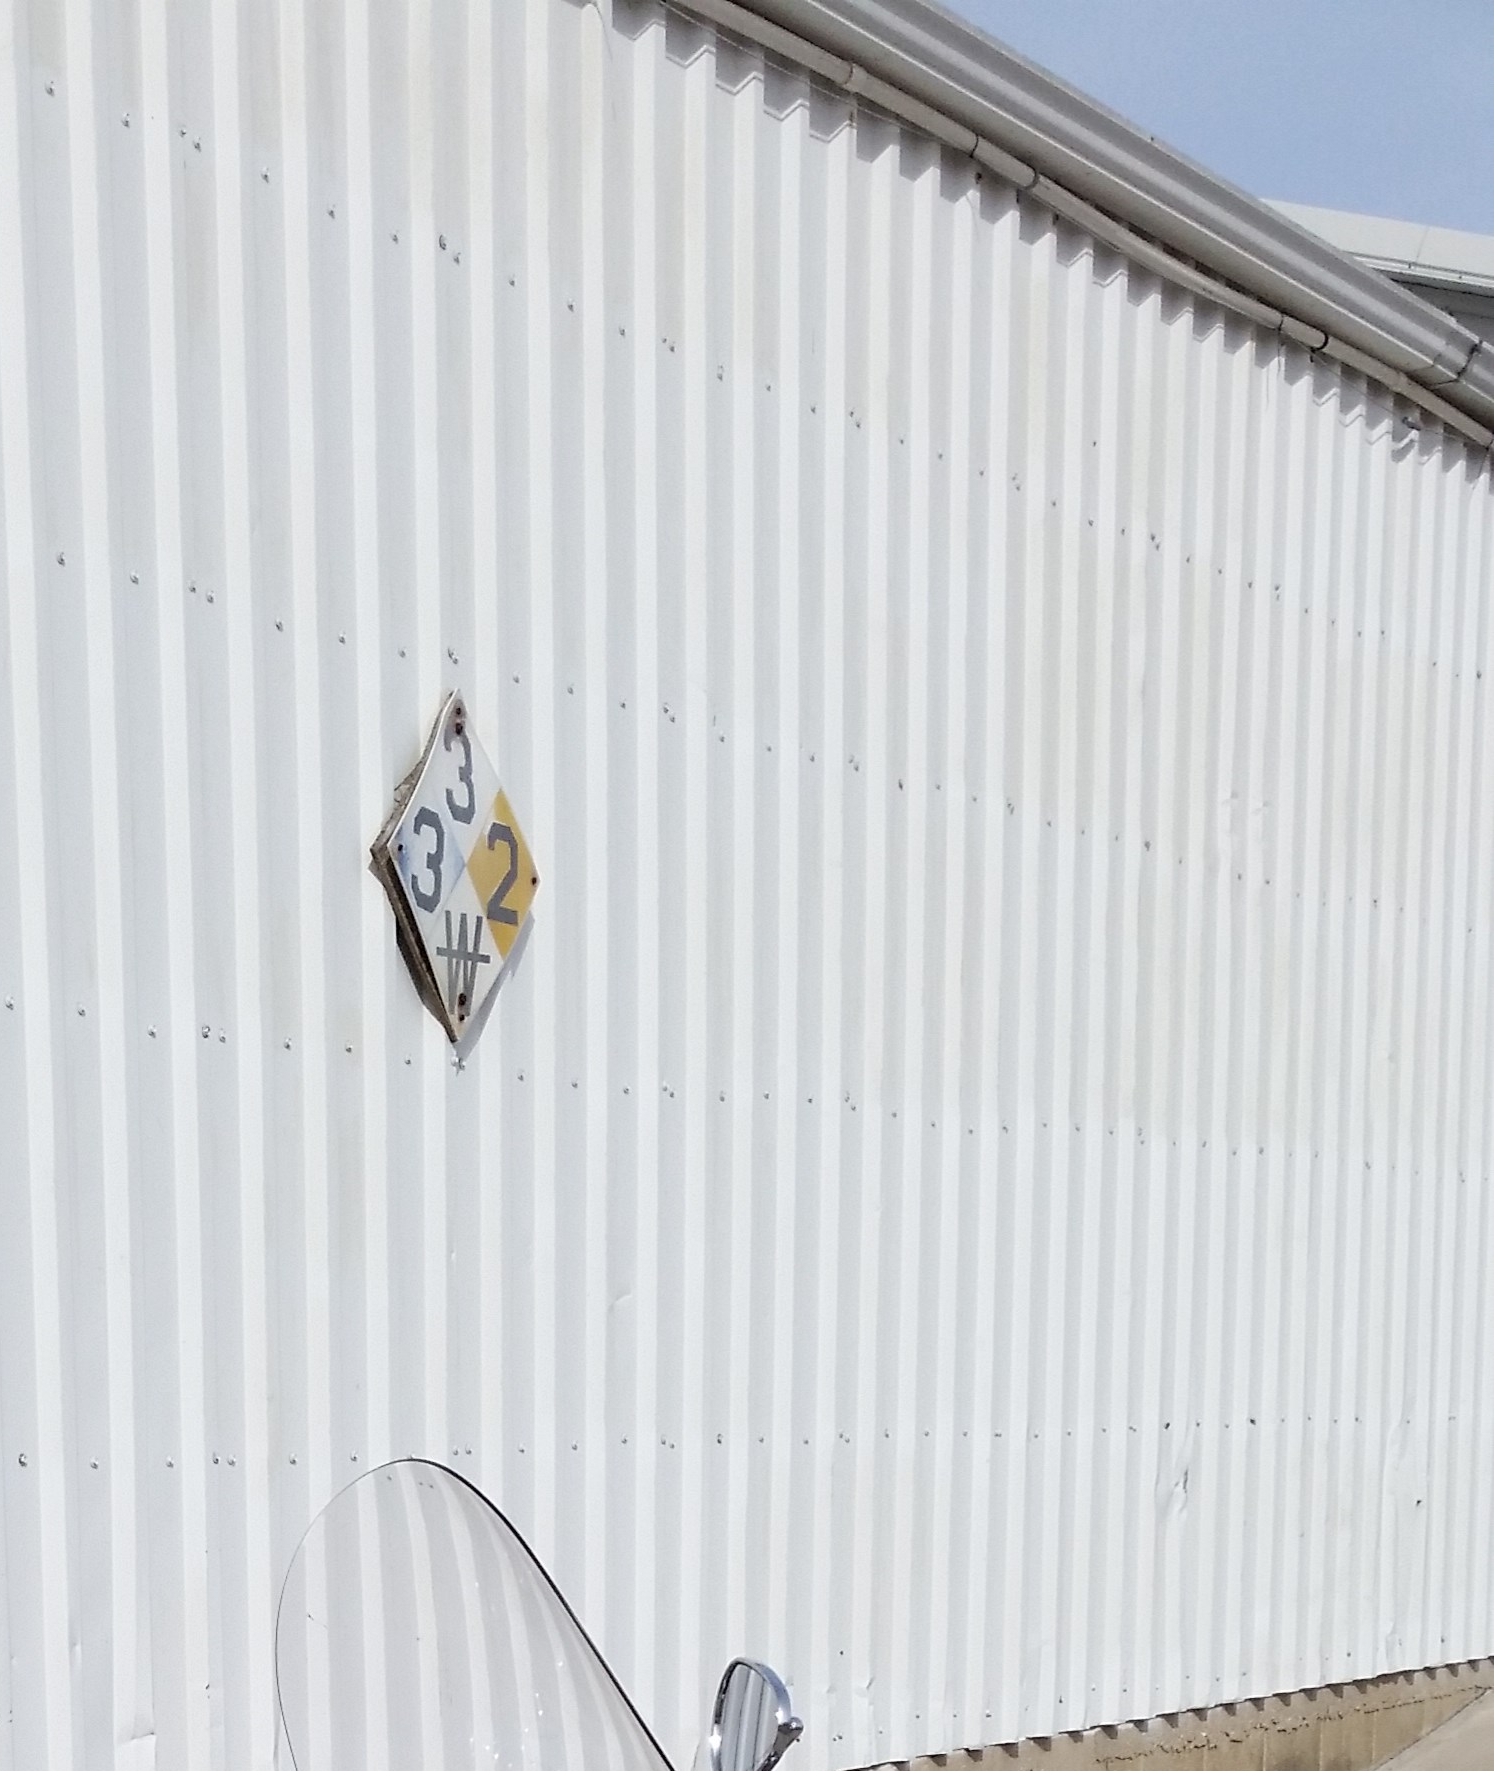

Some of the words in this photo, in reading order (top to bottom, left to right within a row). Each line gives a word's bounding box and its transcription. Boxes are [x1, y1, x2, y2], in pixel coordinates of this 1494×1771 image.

[444, 727, 476, 825] 3
[411, 806, 445, 913] 3
[486, 822, 518, 926] 2
